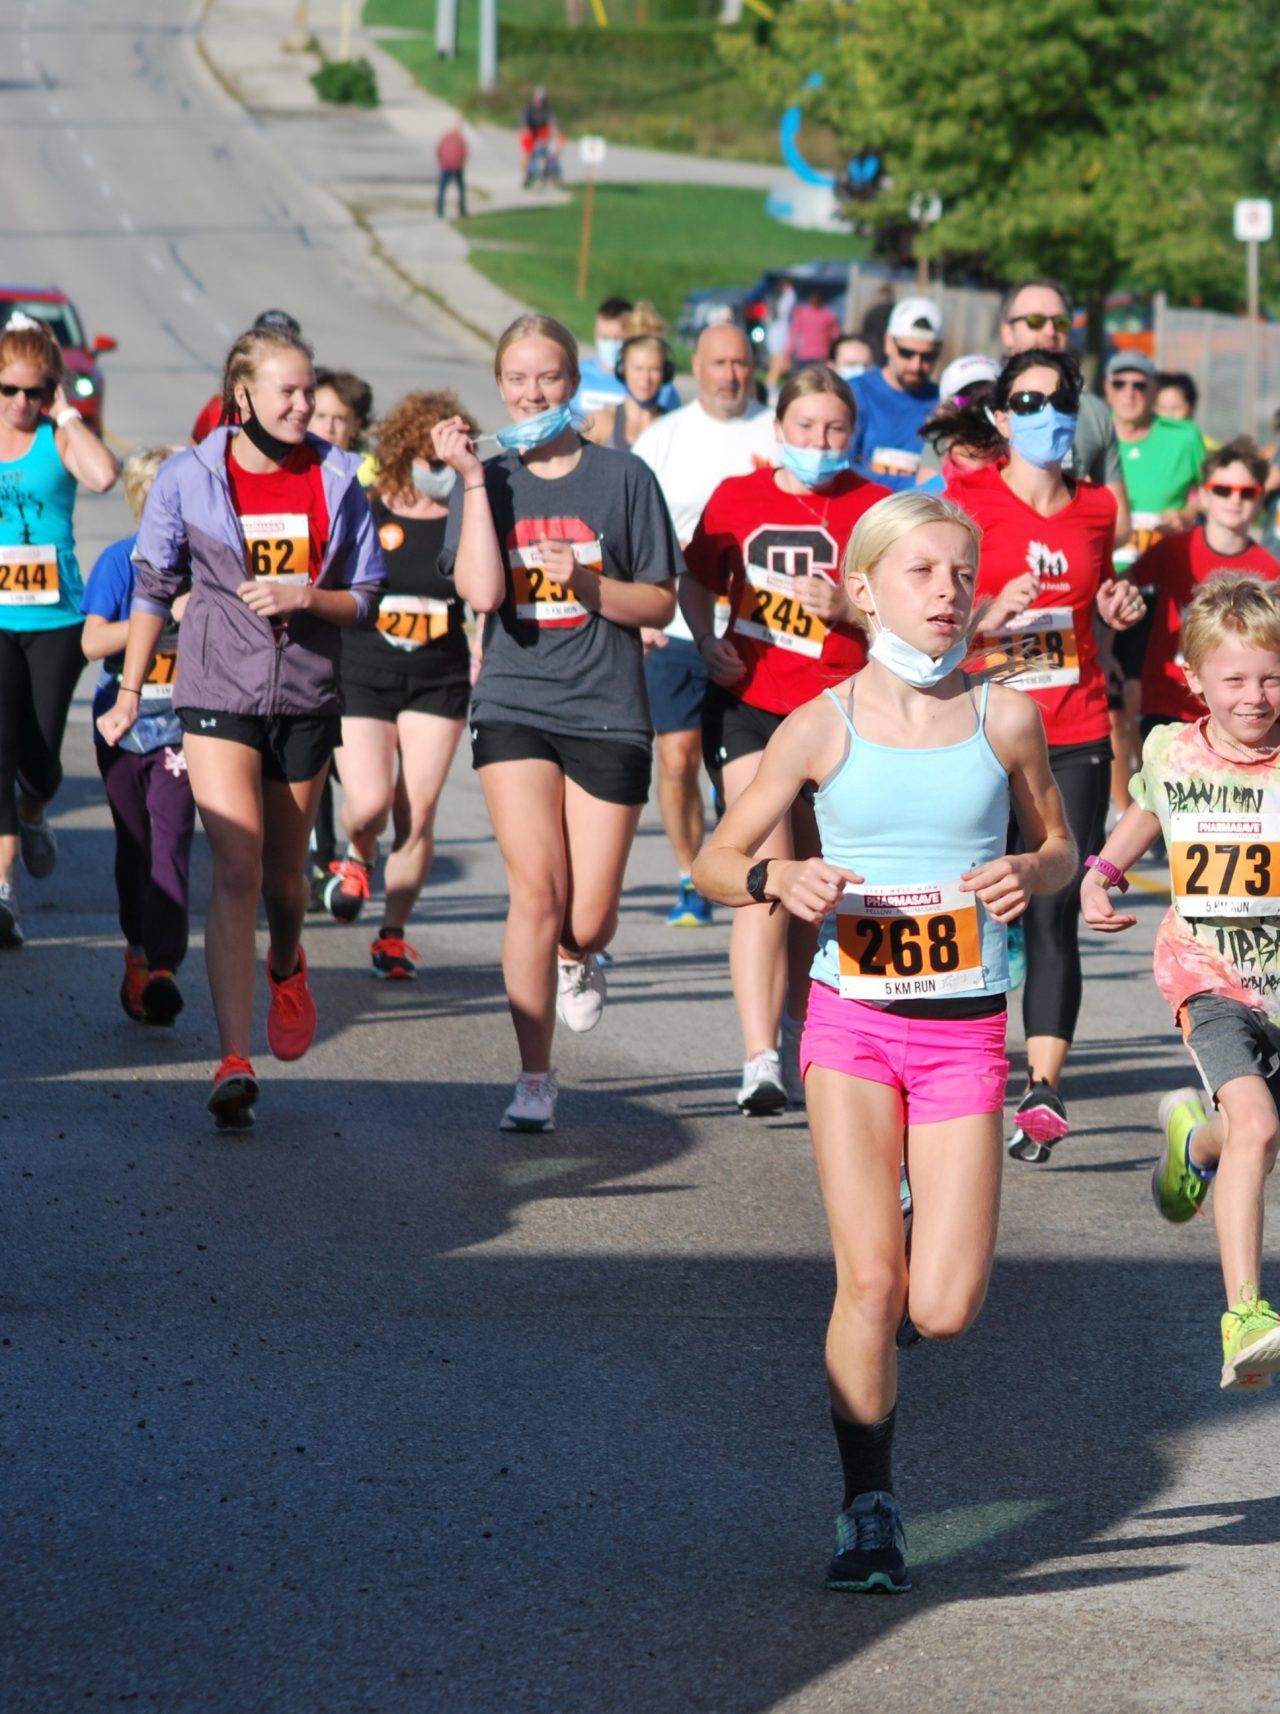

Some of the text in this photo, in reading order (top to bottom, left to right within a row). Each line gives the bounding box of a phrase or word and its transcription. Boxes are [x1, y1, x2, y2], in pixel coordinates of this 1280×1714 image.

[0, 564, 47, 591] 244
[387, 611, 431, 642] 271
[750, 589, 813, 638] 245
[1200, 822, 1260, 833] PHARMASAVE
[1186, 843, 1271, 896] 273
[866, 893, 939, 907] PHARMASAVE
[1206, 901, 1211, 912] 5
[855, 915, 960, 976] 268
[885, 982, 892, 995] 5
[895, 982, 911, 994] KM
[914, 980, 936, 993] RUN
